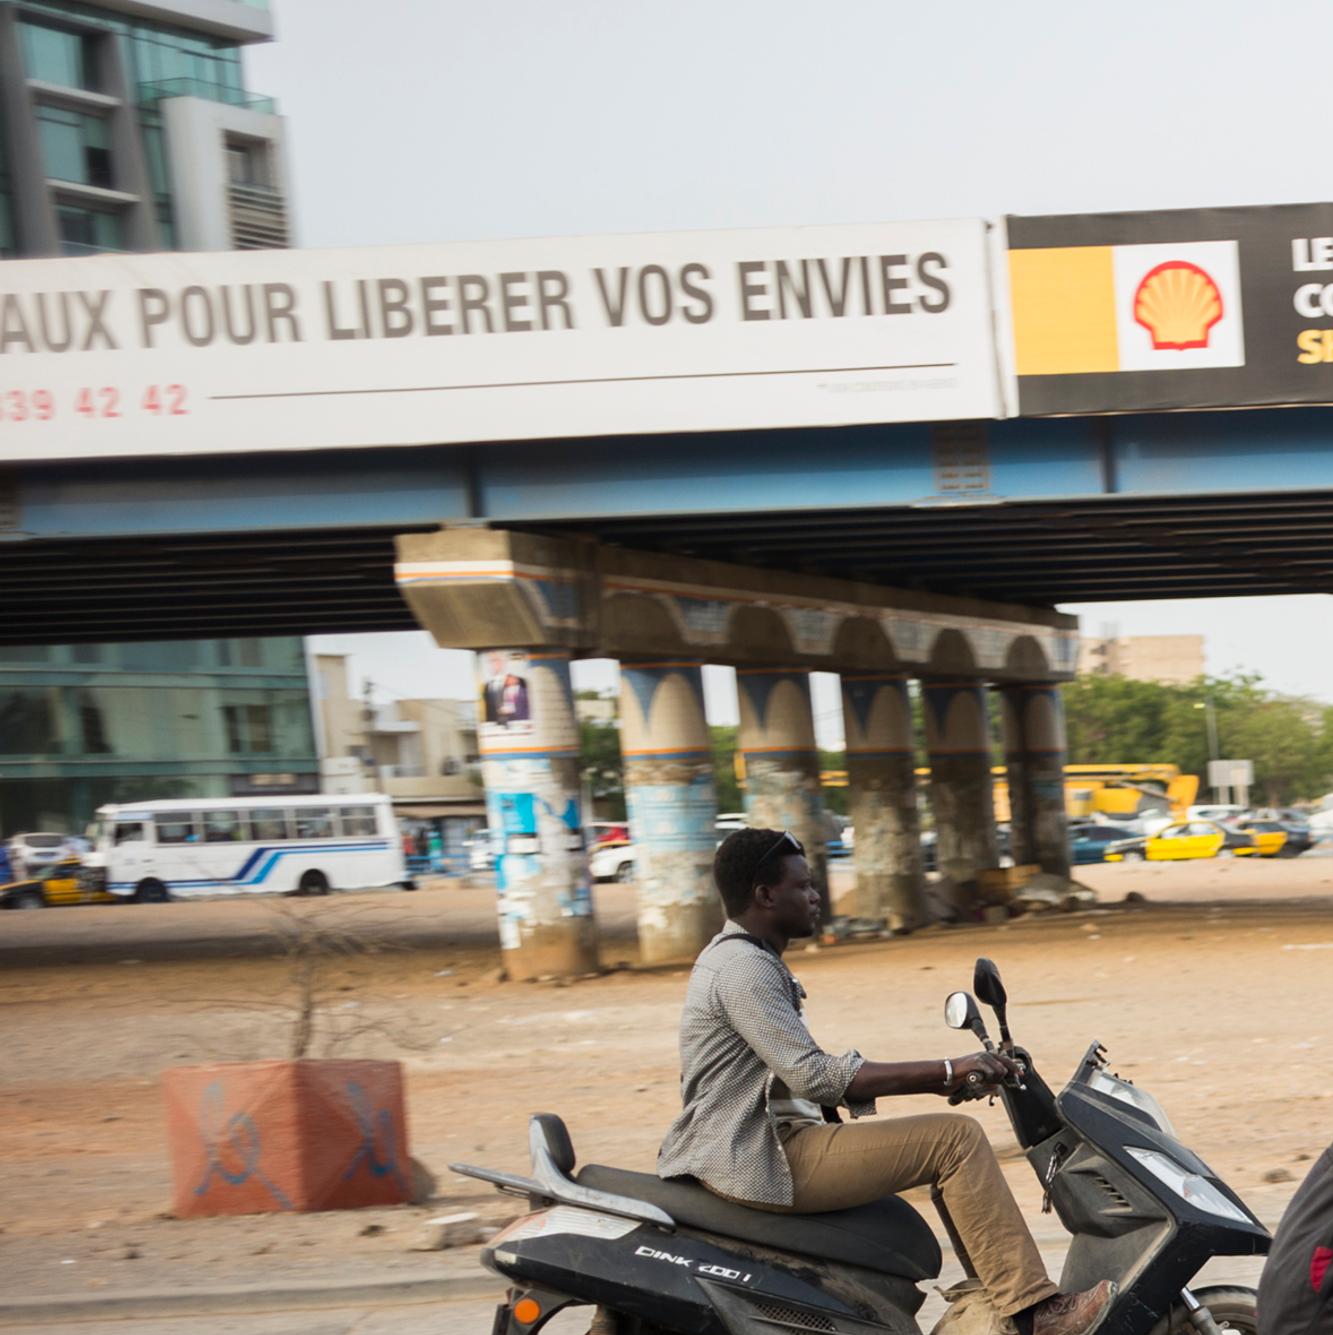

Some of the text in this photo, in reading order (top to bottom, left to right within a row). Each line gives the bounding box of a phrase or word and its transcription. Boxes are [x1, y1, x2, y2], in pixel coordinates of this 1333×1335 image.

[136, 283, 302, 348] POUR
[323, 270, 575, 340] LIBERER
[593, 263, 714, 327] VOS
[737, 252, 951, 321] ENVIES
[0, 384, 188, 422] 39 42 42
[635, 1246, 692, 1267] DINK
[698, 1264, 740, 1279] 200
